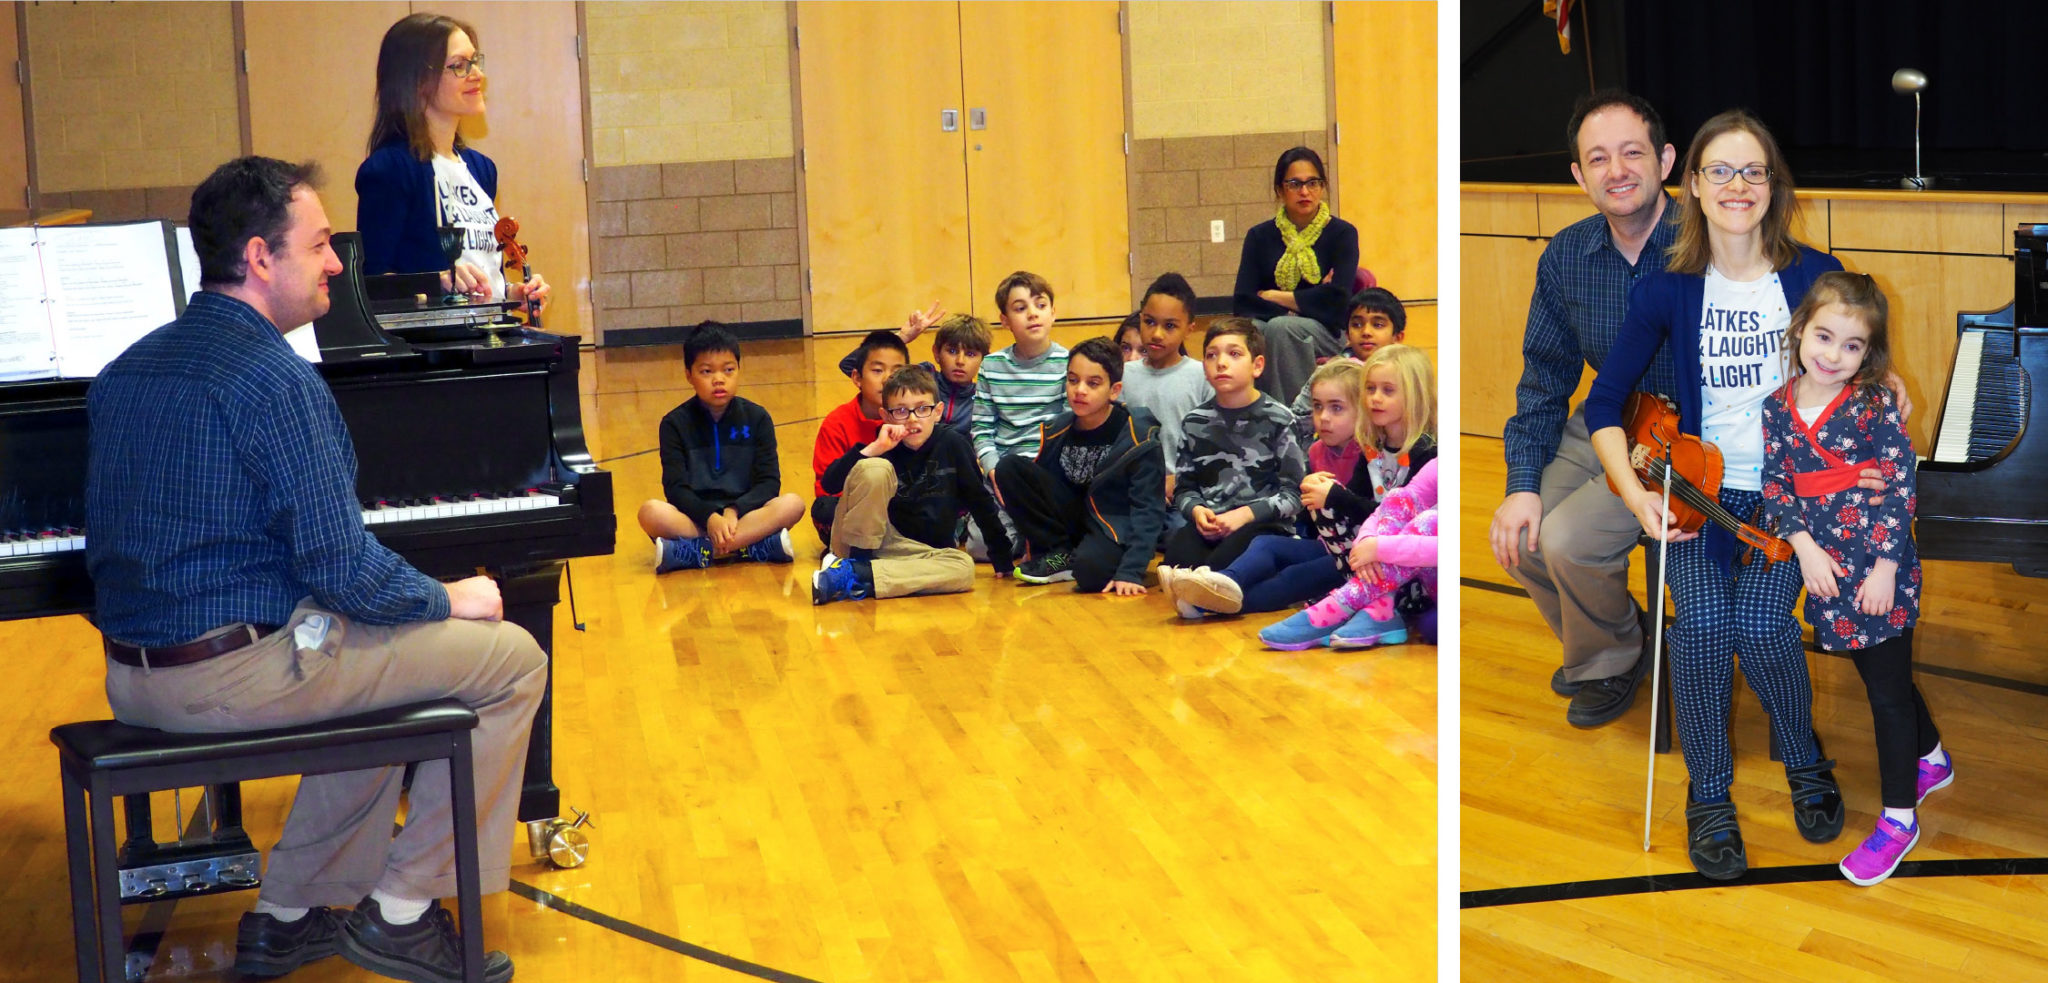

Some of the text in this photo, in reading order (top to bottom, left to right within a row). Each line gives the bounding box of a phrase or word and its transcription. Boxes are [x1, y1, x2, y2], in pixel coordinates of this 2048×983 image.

[438, 180, 478, 206] LKES
[467, 228, 494, 253] LIGHT
[1708, 328, 1788, 357] LAUGHTE
[1709, 363, 1763, 388] LIGHT
